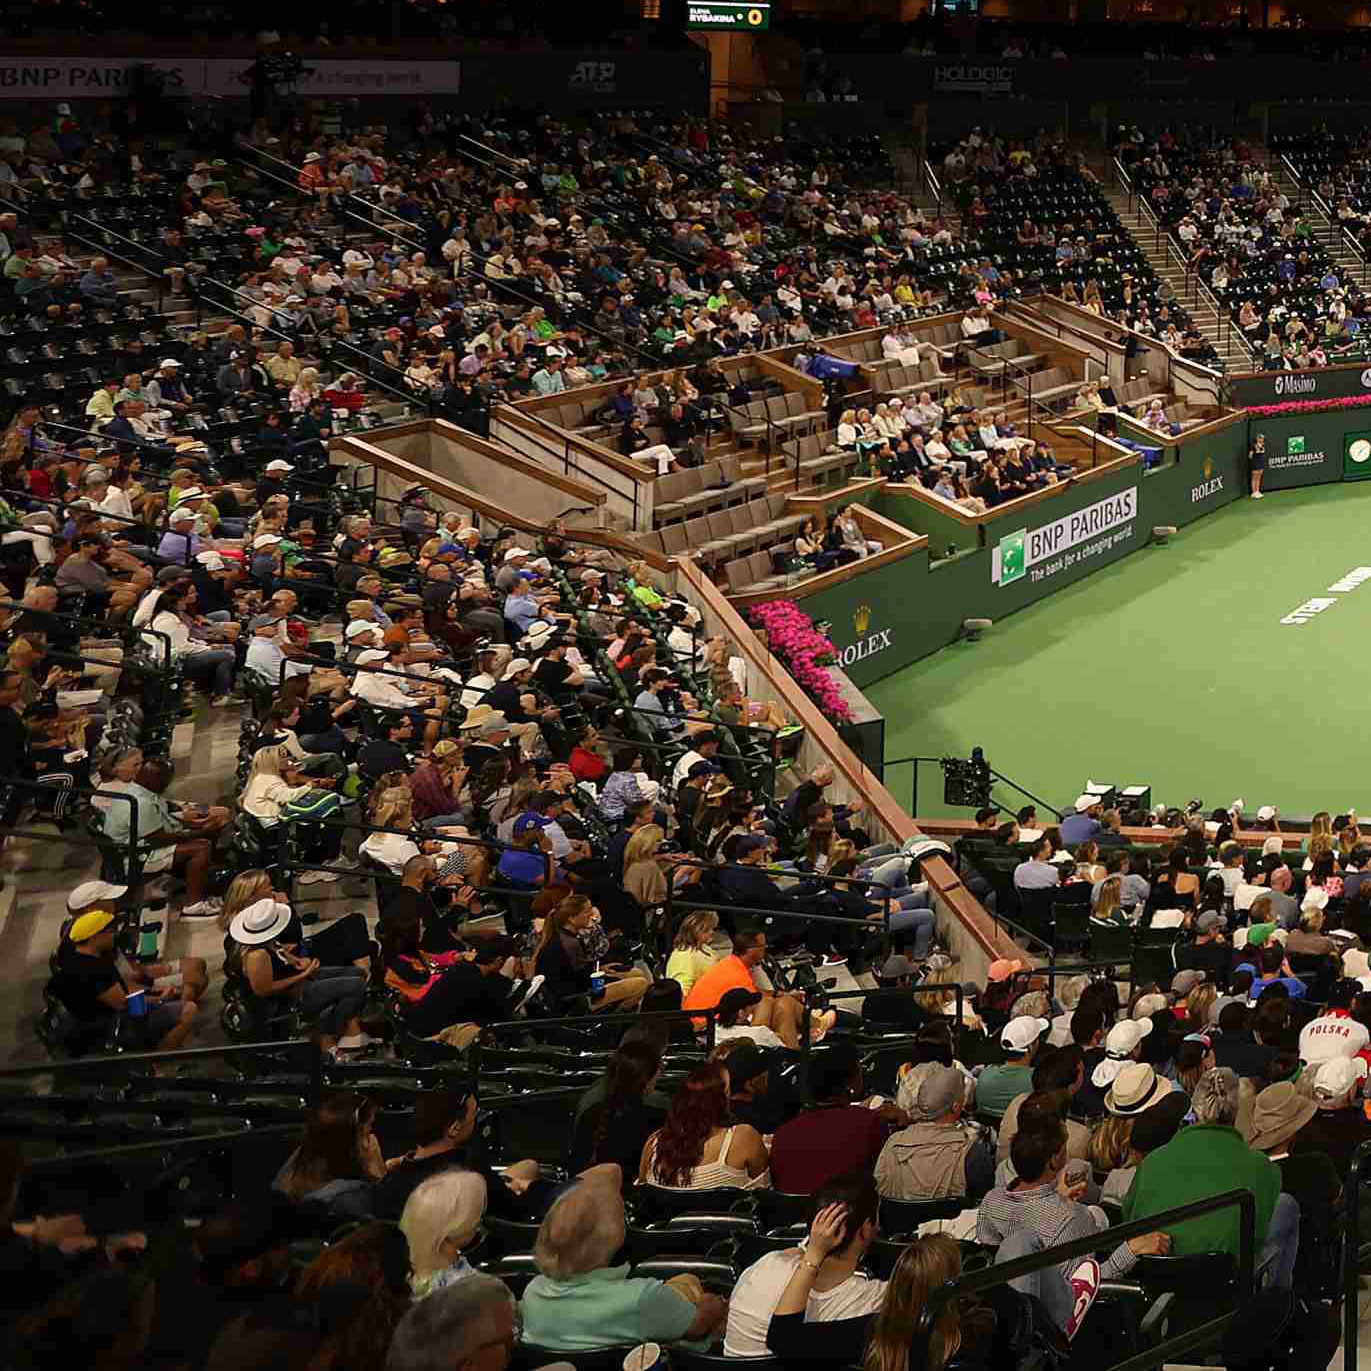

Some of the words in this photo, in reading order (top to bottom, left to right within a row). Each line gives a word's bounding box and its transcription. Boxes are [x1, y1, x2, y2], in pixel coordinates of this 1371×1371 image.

[748, 9, 763, 25] 0
[1191, 475, 1224, 502] ROLEX
[1031, 524, 1064, 560] BNP
[1071, 493, 1131, 541] PARIBAS
[1031, 565, 1045, 582] The
[1045, 558, 1063, 576] bank
[1063, 552, 1075, 570] for
[1082, 534, 1113, 559] changing
[1310, 1024, 1350, 1037] POLSKA
